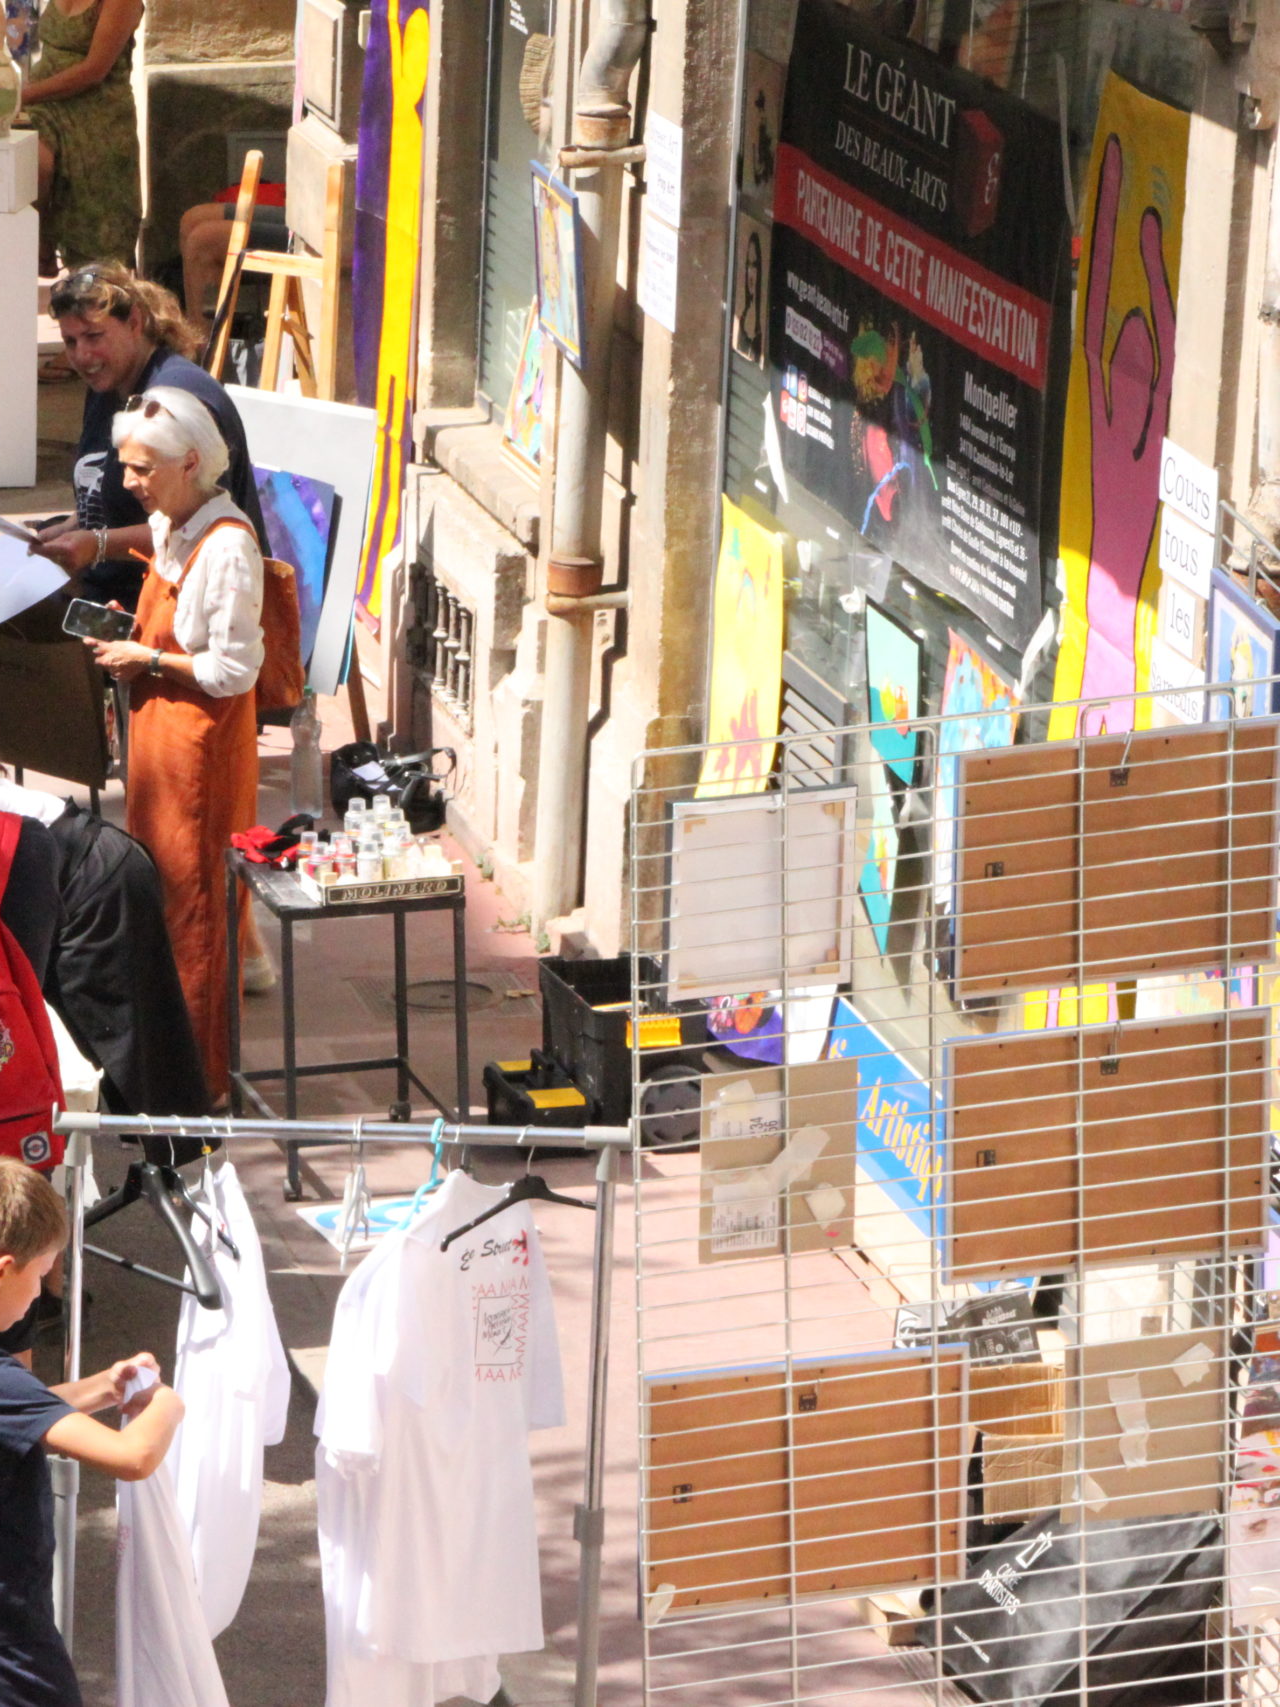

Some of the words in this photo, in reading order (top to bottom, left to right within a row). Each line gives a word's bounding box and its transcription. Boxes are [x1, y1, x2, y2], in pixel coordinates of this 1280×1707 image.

[843, 42, 872, 101] LE
[875, 58, 956, 148] GÉANT
[835, 120, 862, 160] DES
[862, 136, 948, 213] BEAUX-ARTS
[797, 169, 862, 260] PARTENAIRE
[865, 215, 883, 273] DE
[884, 230, 925, 300] CETTE
[926, 256, 1039, 369] MANIFESTATION
[964, 371, 1018, 430] Montpellier
[1163, 457, 1210, 521] Cours
[1164, 525, 1198, 577] tous
[1170, 592, 1191, 640] les
[342, 880, 448, 901] MOLINERO
